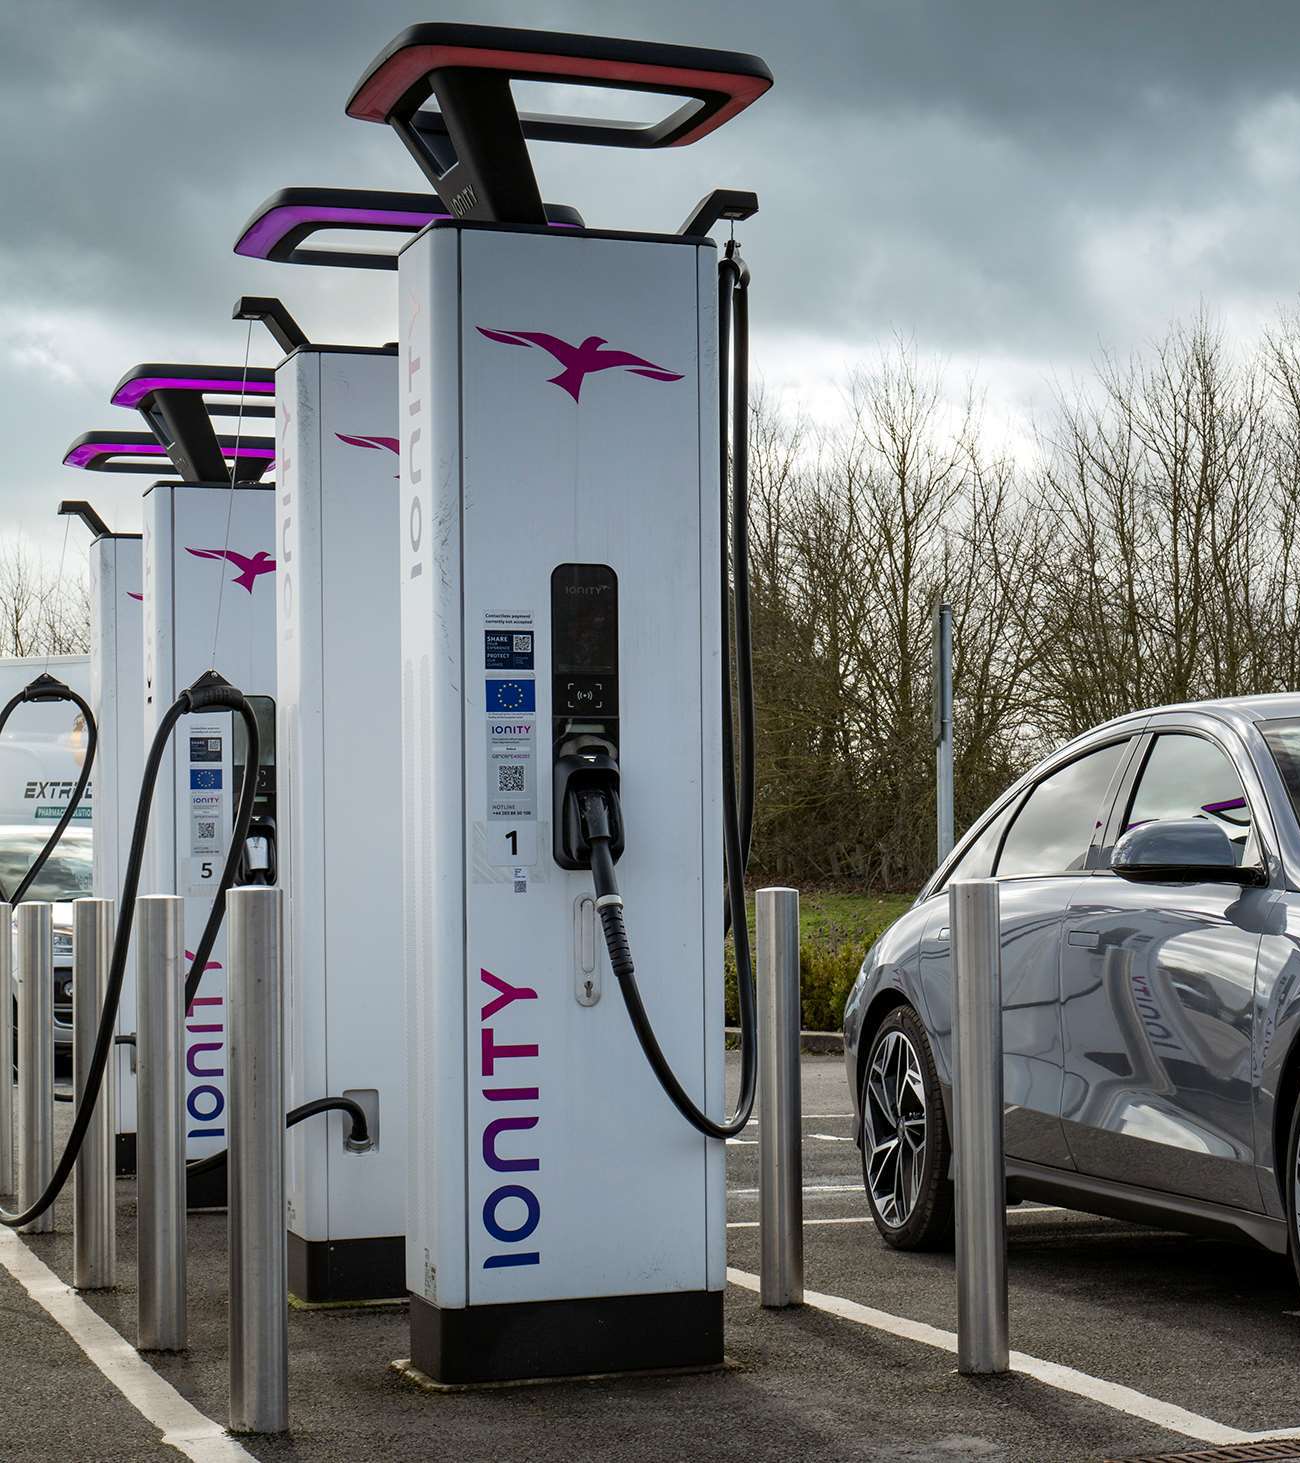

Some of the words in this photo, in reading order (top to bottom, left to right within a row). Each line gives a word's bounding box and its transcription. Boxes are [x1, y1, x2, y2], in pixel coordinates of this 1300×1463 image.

[565, 585, 601, 596] IONITY
[491, 725, 531, 734] IONITY
[24, 781, 92, 799] EXTR
[38, 808, 66, 817] PHARMAC
[505, 830, 517, 855] 1
[201, 863, 213, 878] 5
[480, 967, 541, 1269] IONITY
